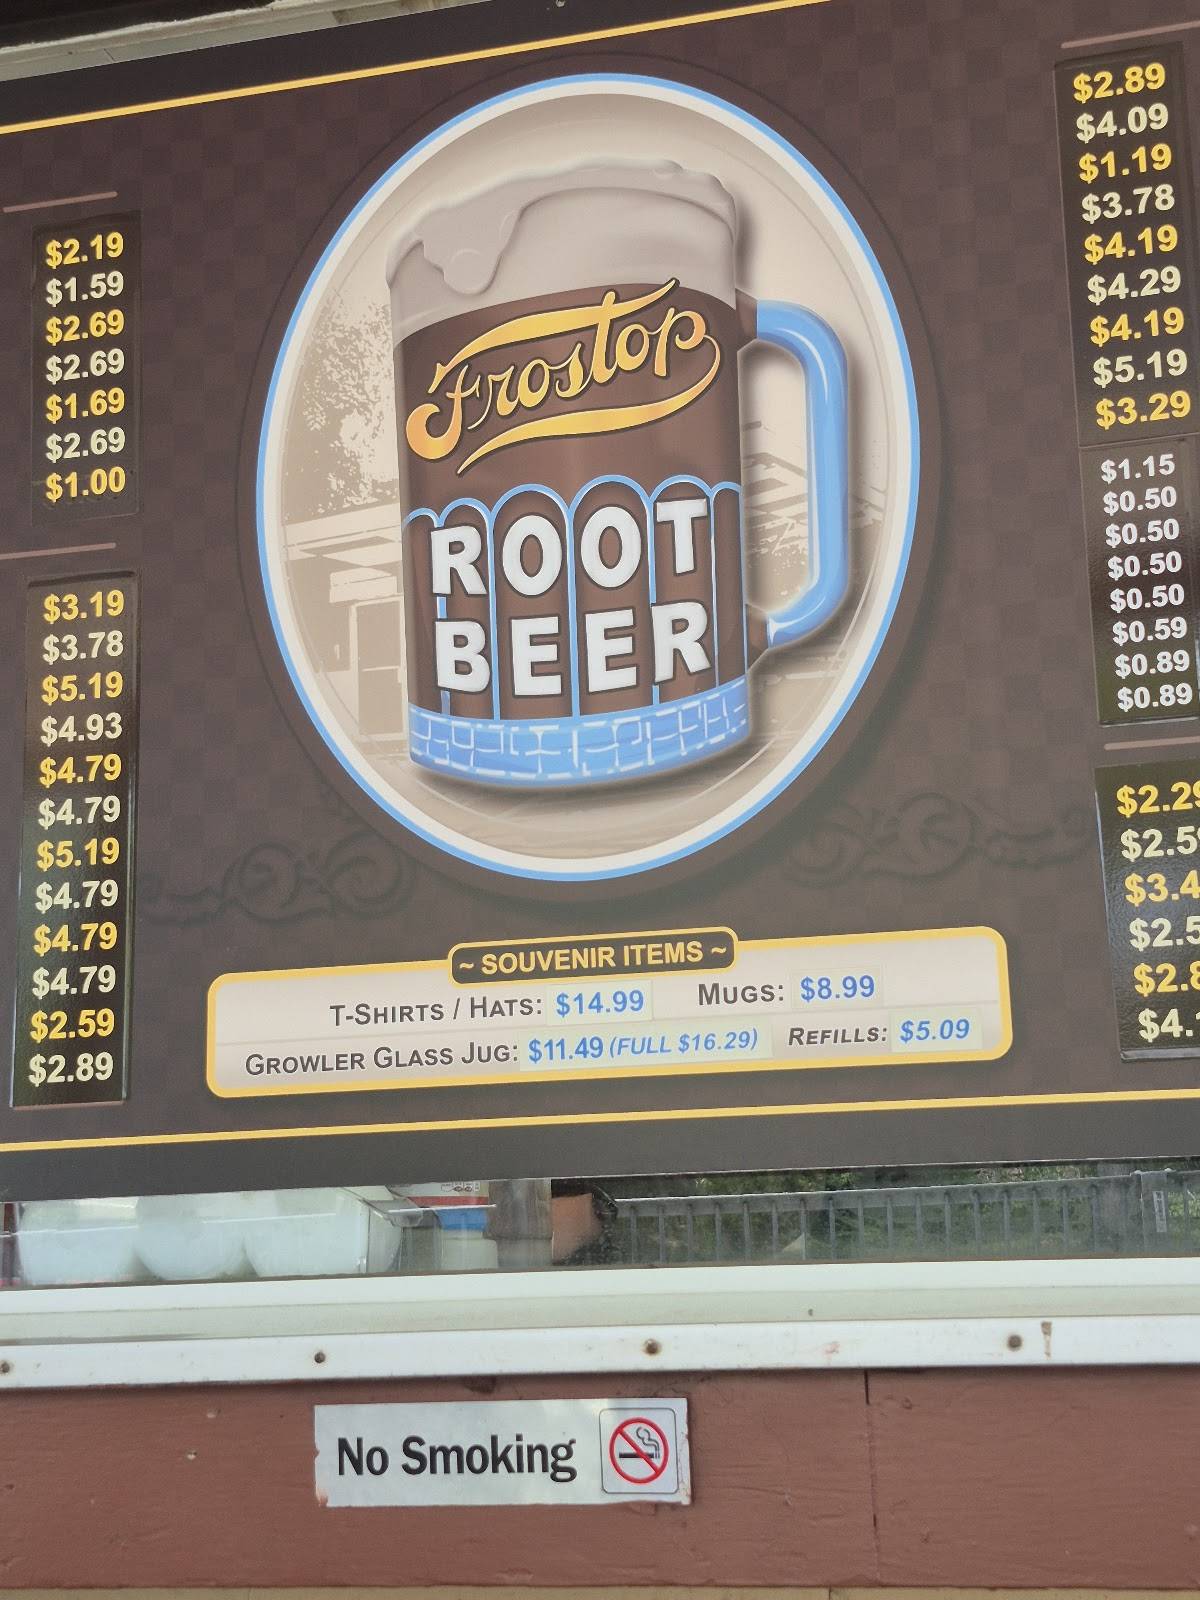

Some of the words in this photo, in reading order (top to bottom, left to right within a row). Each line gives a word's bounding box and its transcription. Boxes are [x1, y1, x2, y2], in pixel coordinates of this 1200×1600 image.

[1073, 62, 1166, 104] $2.89
[1076, 102, 1169, 145] $4.09
[1078, 142, 1172, 185] $1.19
[1081, 183, 1175, 225] $3.78
[45, 231, 124, 270] $2.19
[1084, 223, 1178, 266] $4.19
[45, 270, 124, 308] $1.59
[1087, 265, 1181, 306] $4.29
[45, 308, 125, 347] $2.69
[1089, 306, 1185, 348] $4.19
[45, 347, 125, 386] $2.69
[404, 278, 721, 475] Frostop
[1092, 348, 1188, 389] $5.19
[45, 387, 125, 425] $1.69
[1095, 389, 1191, 431] $3.29
[45, 426, 126, 464] $2.69
[45, 465, 126, 504] $1.00
[1100, 453, 1176, 485] $1.15
[1102, 485, 1177, 517] $0.50
[430, 497, 708, 597] ROOT
[1105, 518, 1180, 549] $0.50
[1107, 550, 1182, 581] $0.50
[42, 589, 125, 625] $3.19
[1110, 583, 1185, 614] $0.50
[42, 629, 124, 666] $3.78
[434, 601, 711, 697] BEER
[1112, 616, 1188, 647] $0.59
[1114, 649, 1190, 680] $0.89
[41, 670, 124, 707] $5.19
[1117, 682, 1193, 713] $0.89
[40, 711, 123, 748] $4.93
[39, 753, 122, 789] $4.79
[37, 795, 121, 831] $4.79
[36, 837, 120, 873] $5.19
[1120, 825, 1200, 862] $2.5
[34, 879, 119, 915] $4.79
[33, 921, 118, 958] $4.79
[480, 946, 617, 976] SOUVENIR
[623, 940, 704, 967] ITEMS
[31, 964, 116, 1000] $4.79
[329, 1002, 445, 1027] T-SHIRTS
[452, 997, 461, 1020] /
[470, 996, 542, 1019] HATS:
[555, 989, 645, 1018] $14.99
[698, 982, 784, 1006] MUGS:
[799, 975, 875, 1003] $8.99
[29, 1007, 115, 1044] $2.59
[245, 1052, 366, 1076] GROWLER
[373, 1046, 454, 1069] GLASS
[461, 1041, 518, 1064] JUG:
[527, 1035, 604, 1064] $11.49
[609, 1035, 671, 1058] (FULL
[677, 1028, 758, 1054] $16.29)
[788, 1026, 887, 1046] REFILLS:
[899, 1018, 971, 1044] $5.09
[28, 1051, 114, 1088] $2.89
[337, 1436, 390, 1476] No
[401, 1433, 578, 1483] Smoking
